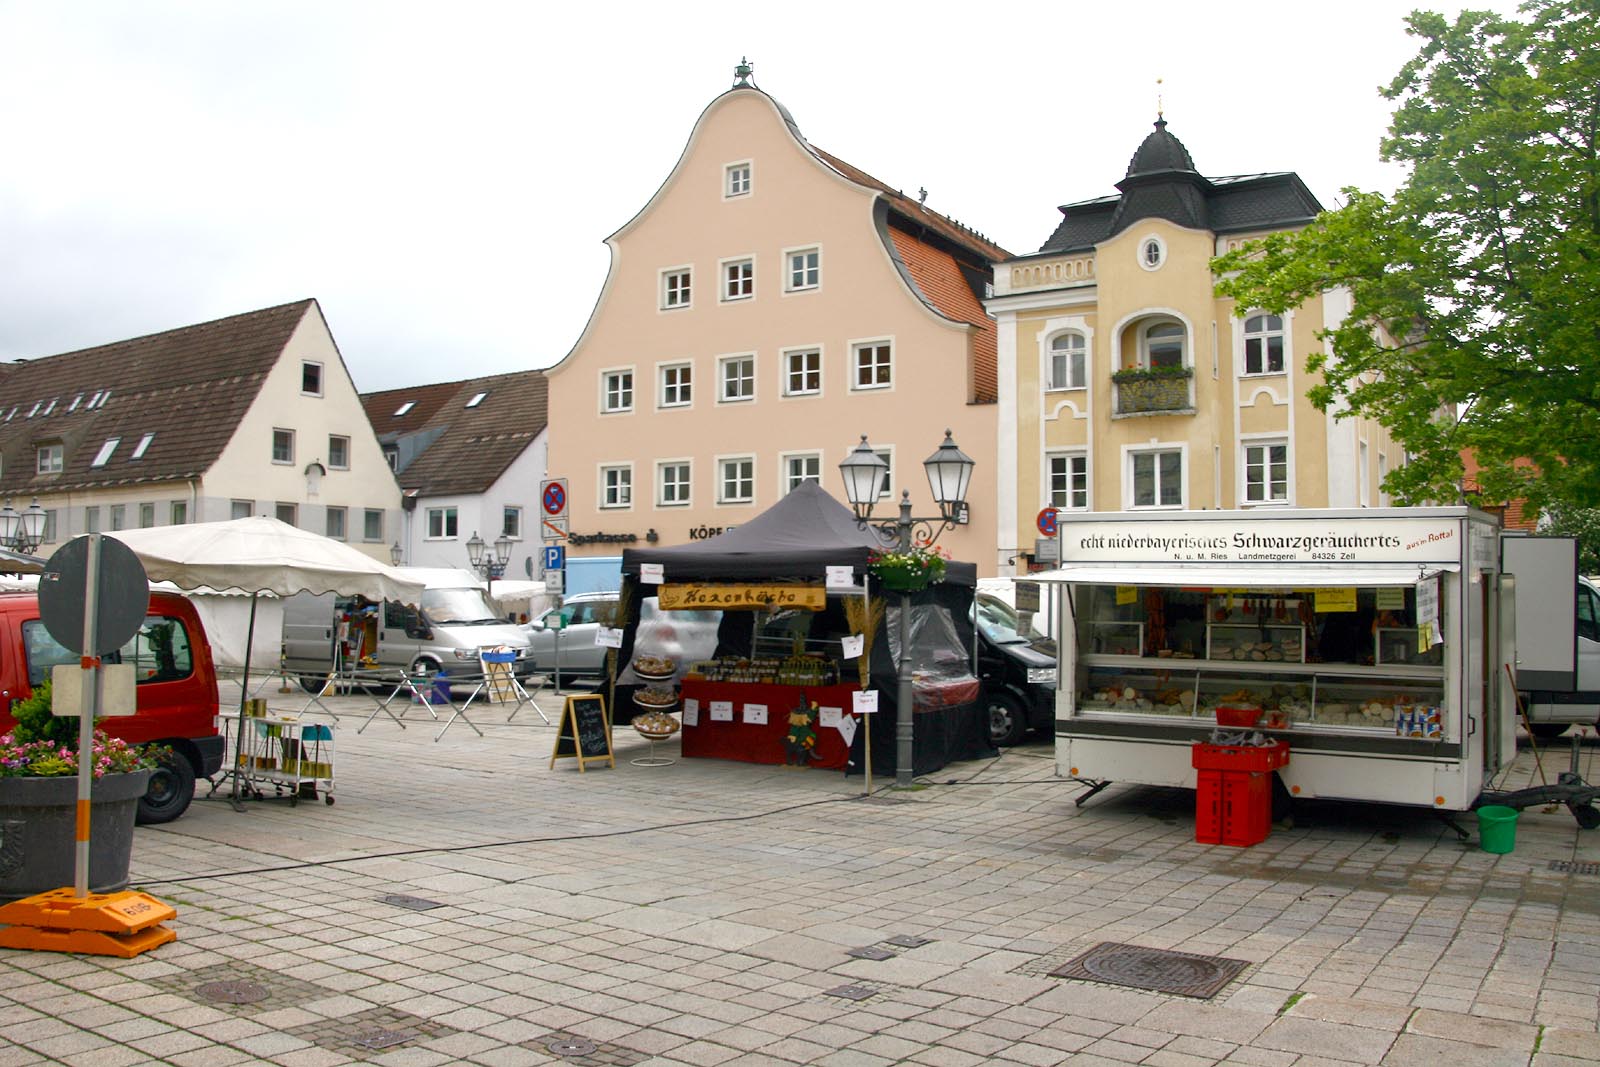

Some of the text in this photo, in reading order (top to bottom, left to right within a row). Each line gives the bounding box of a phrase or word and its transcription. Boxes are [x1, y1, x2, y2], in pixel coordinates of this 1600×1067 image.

[568, 531, 638, 546] Sparkasse
[1080, 533, 1105, 549] echt
[1232, 531, 1400, 552] Schwarzgeräuchertes
[1427, 529, 1453, 543] Rottal
[548, 549, 558, 567] P
[1238, 552, 1296, 561] Landmetzgerei
[1340, 552, 1356, 560] Zell
